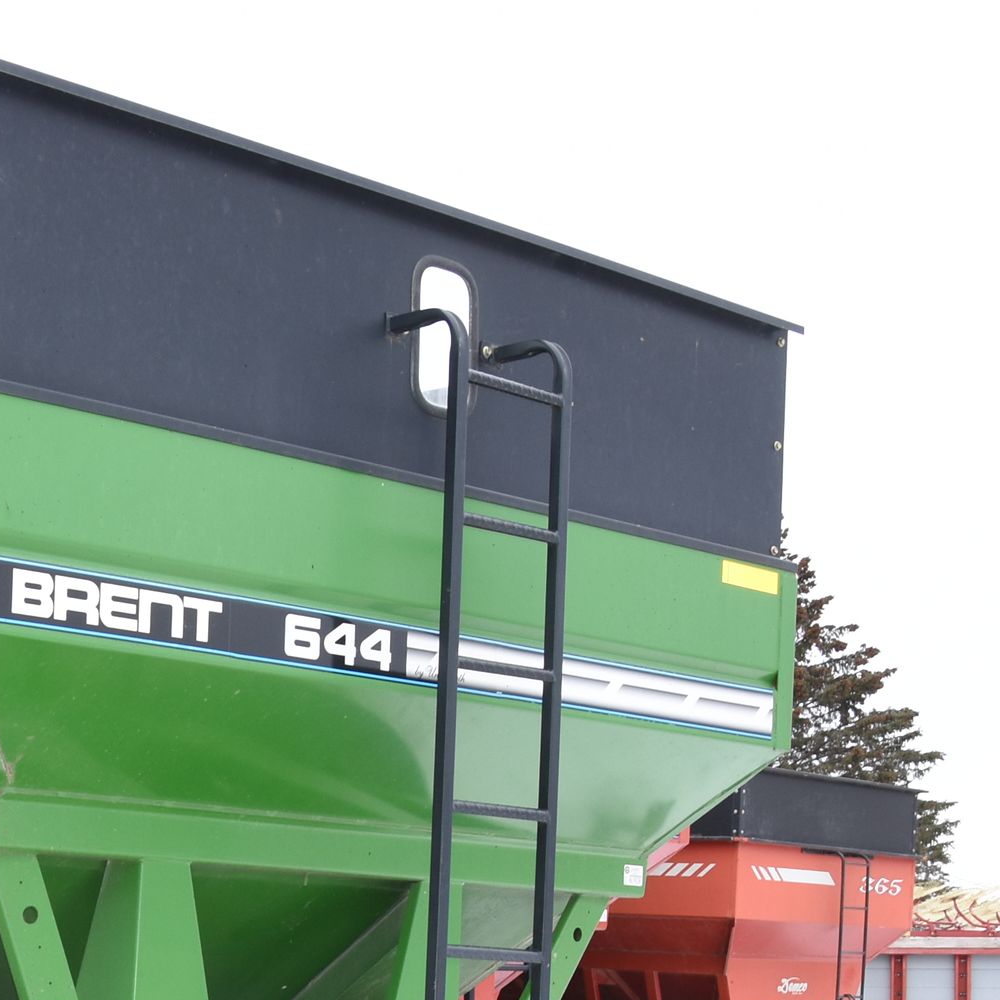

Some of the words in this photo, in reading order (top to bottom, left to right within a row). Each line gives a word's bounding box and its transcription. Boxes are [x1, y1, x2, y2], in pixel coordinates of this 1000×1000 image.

[11, 568, 223, 643] BRENT
[284, 613, 392, 672] 644
[859, 876, 904, 896] 365
